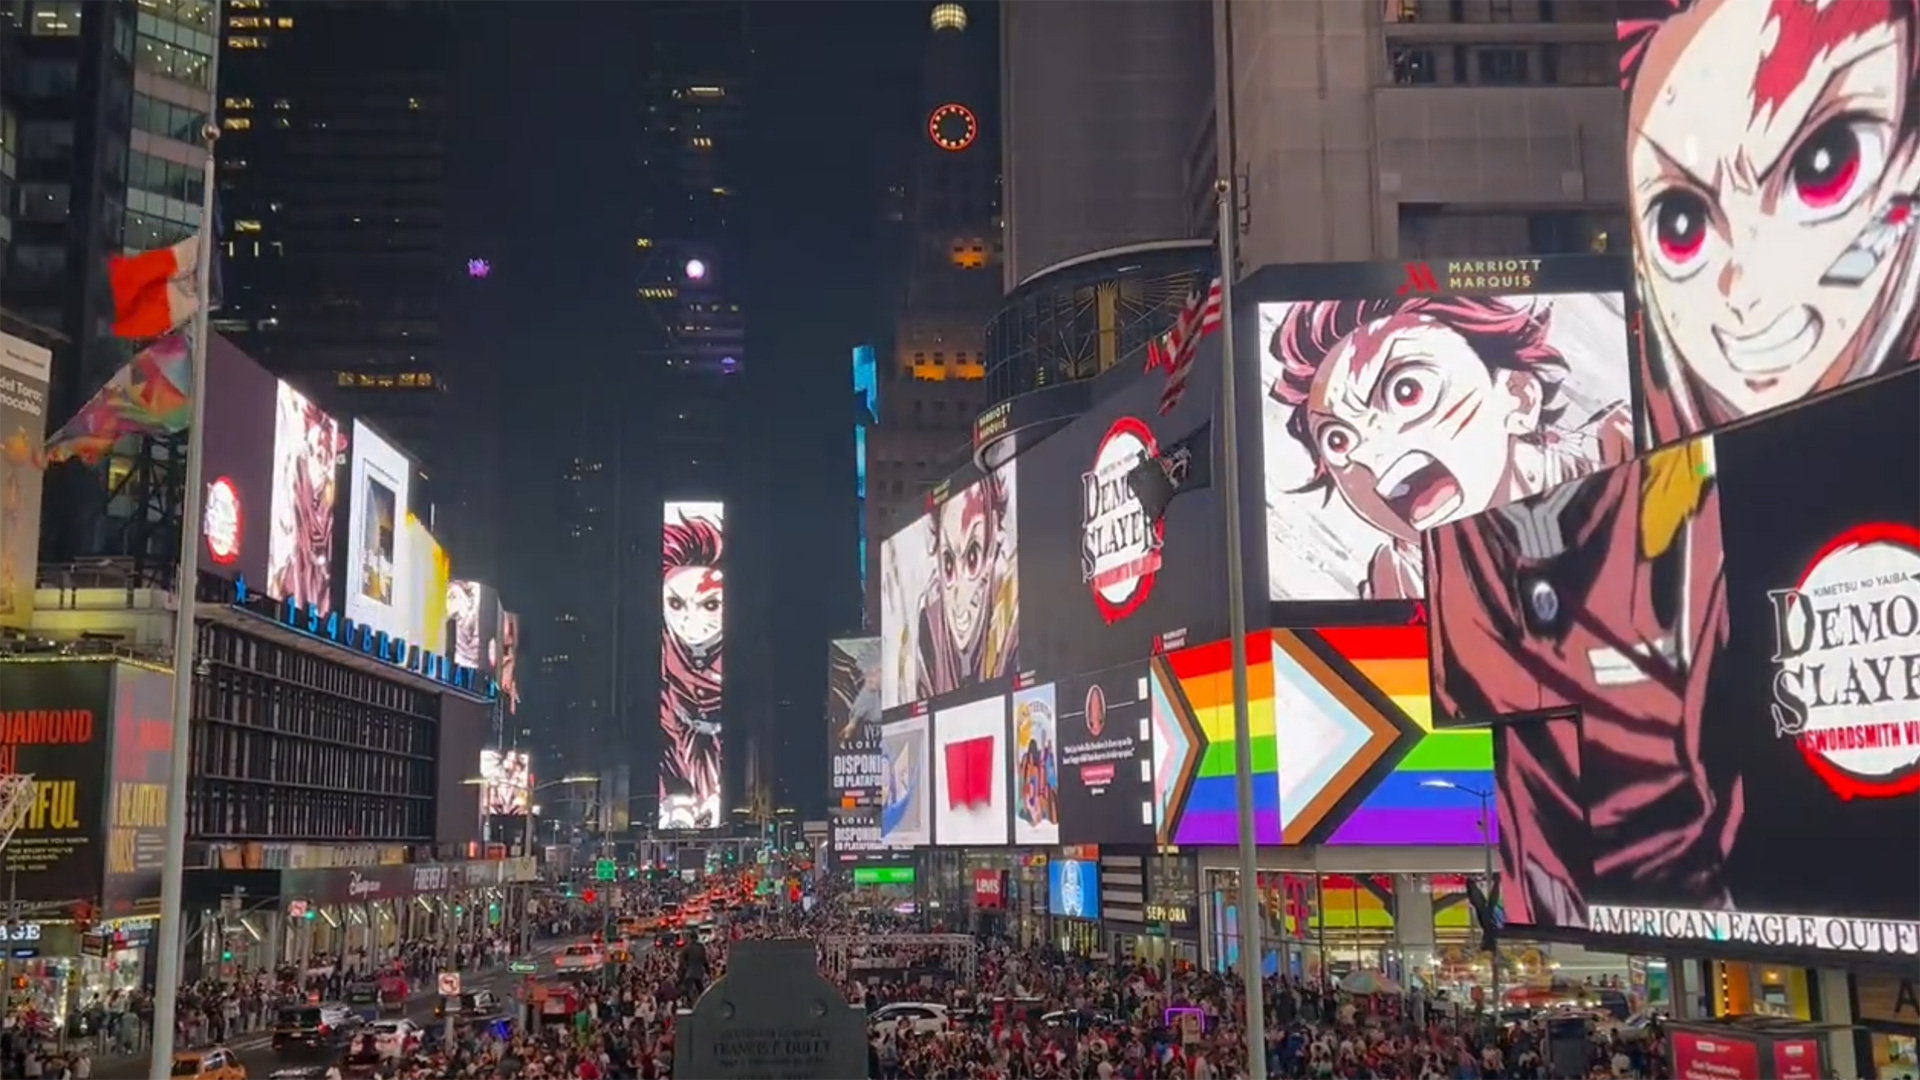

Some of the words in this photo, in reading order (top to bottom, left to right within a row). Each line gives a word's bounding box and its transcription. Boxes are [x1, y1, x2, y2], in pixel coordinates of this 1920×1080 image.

[1449, 259, 1542, 274] MARRIOTT
[1450, 275, 1531, 289] MARQUIS
[16, 382, 42, 402] Toro:
[1081, 510, 1164, 584] SLAYER
[1813, 580, 1858, 598] KIMETSU
[1875, 571, 1910, 587] YAIBA
[1767, 588, 1920, 663] DEMO
[286, 595, 356, 646] 1540
[361, 622, 477, 692] BROADWAY
[1804, 722, 1901, 752] SWORDSMITH
[1146, 905, 1188, 923] SEPHORA
[1592, 908, 1726, 942] AMERICAN
[1729, 913, 1817, 947] EAGLE
